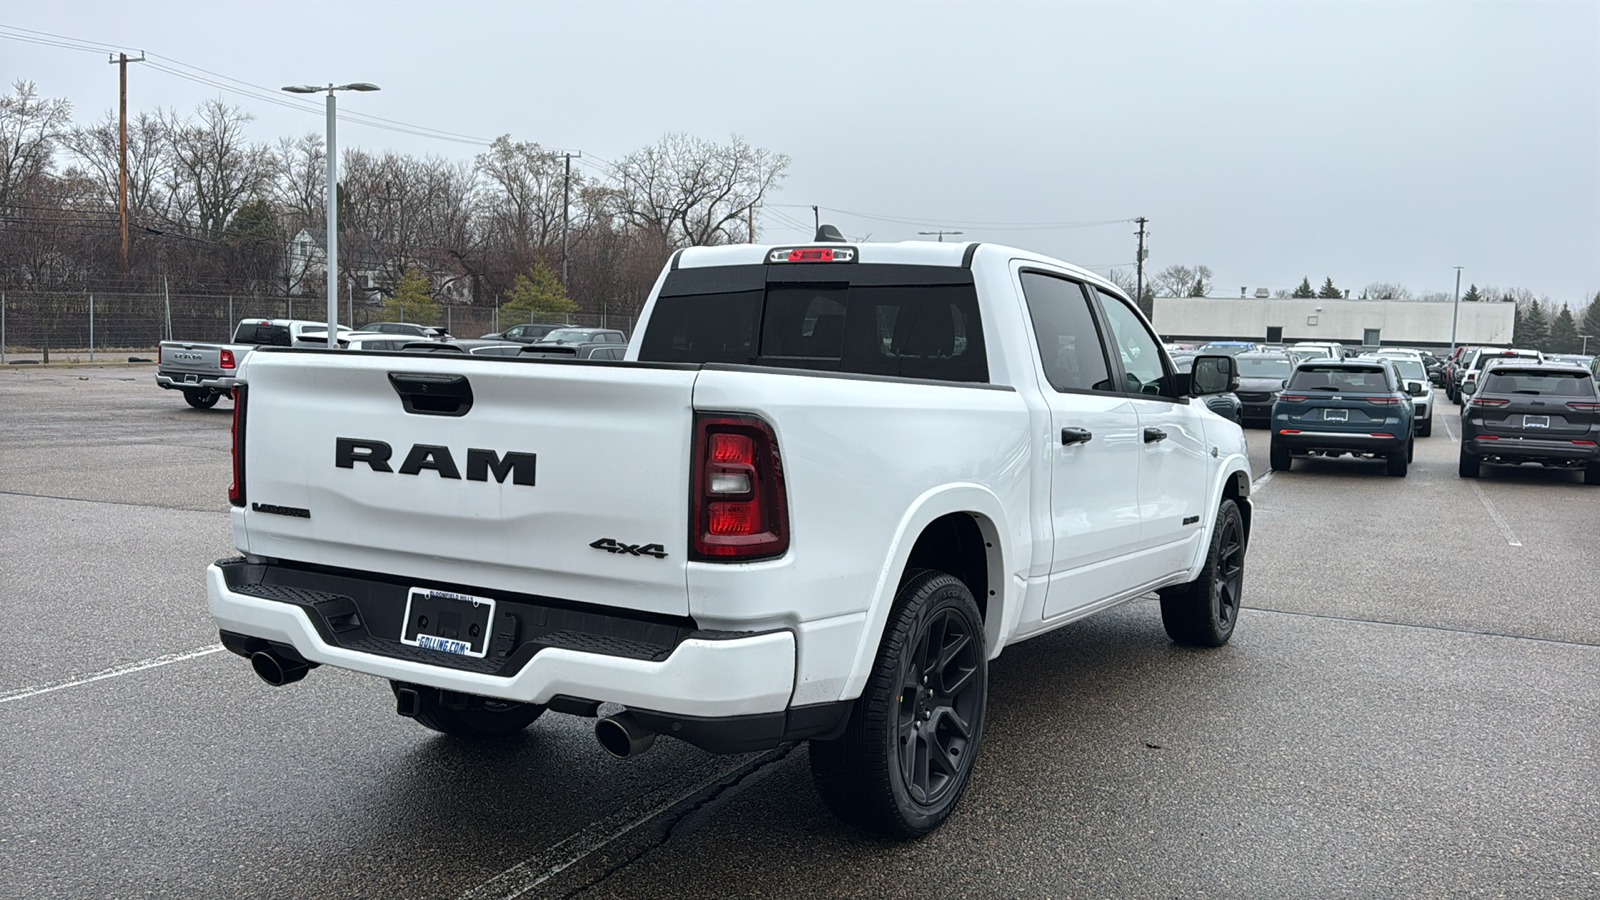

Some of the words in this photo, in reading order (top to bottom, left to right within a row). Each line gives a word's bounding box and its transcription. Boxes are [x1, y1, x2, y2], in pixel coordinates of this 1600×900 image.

[174, 352, 203, 360] RAM
[335, 436, 537, 487] RAM
[589, 537, 669, 559] 4x4
[419, 636, 466, 655] GOLLING.COM
